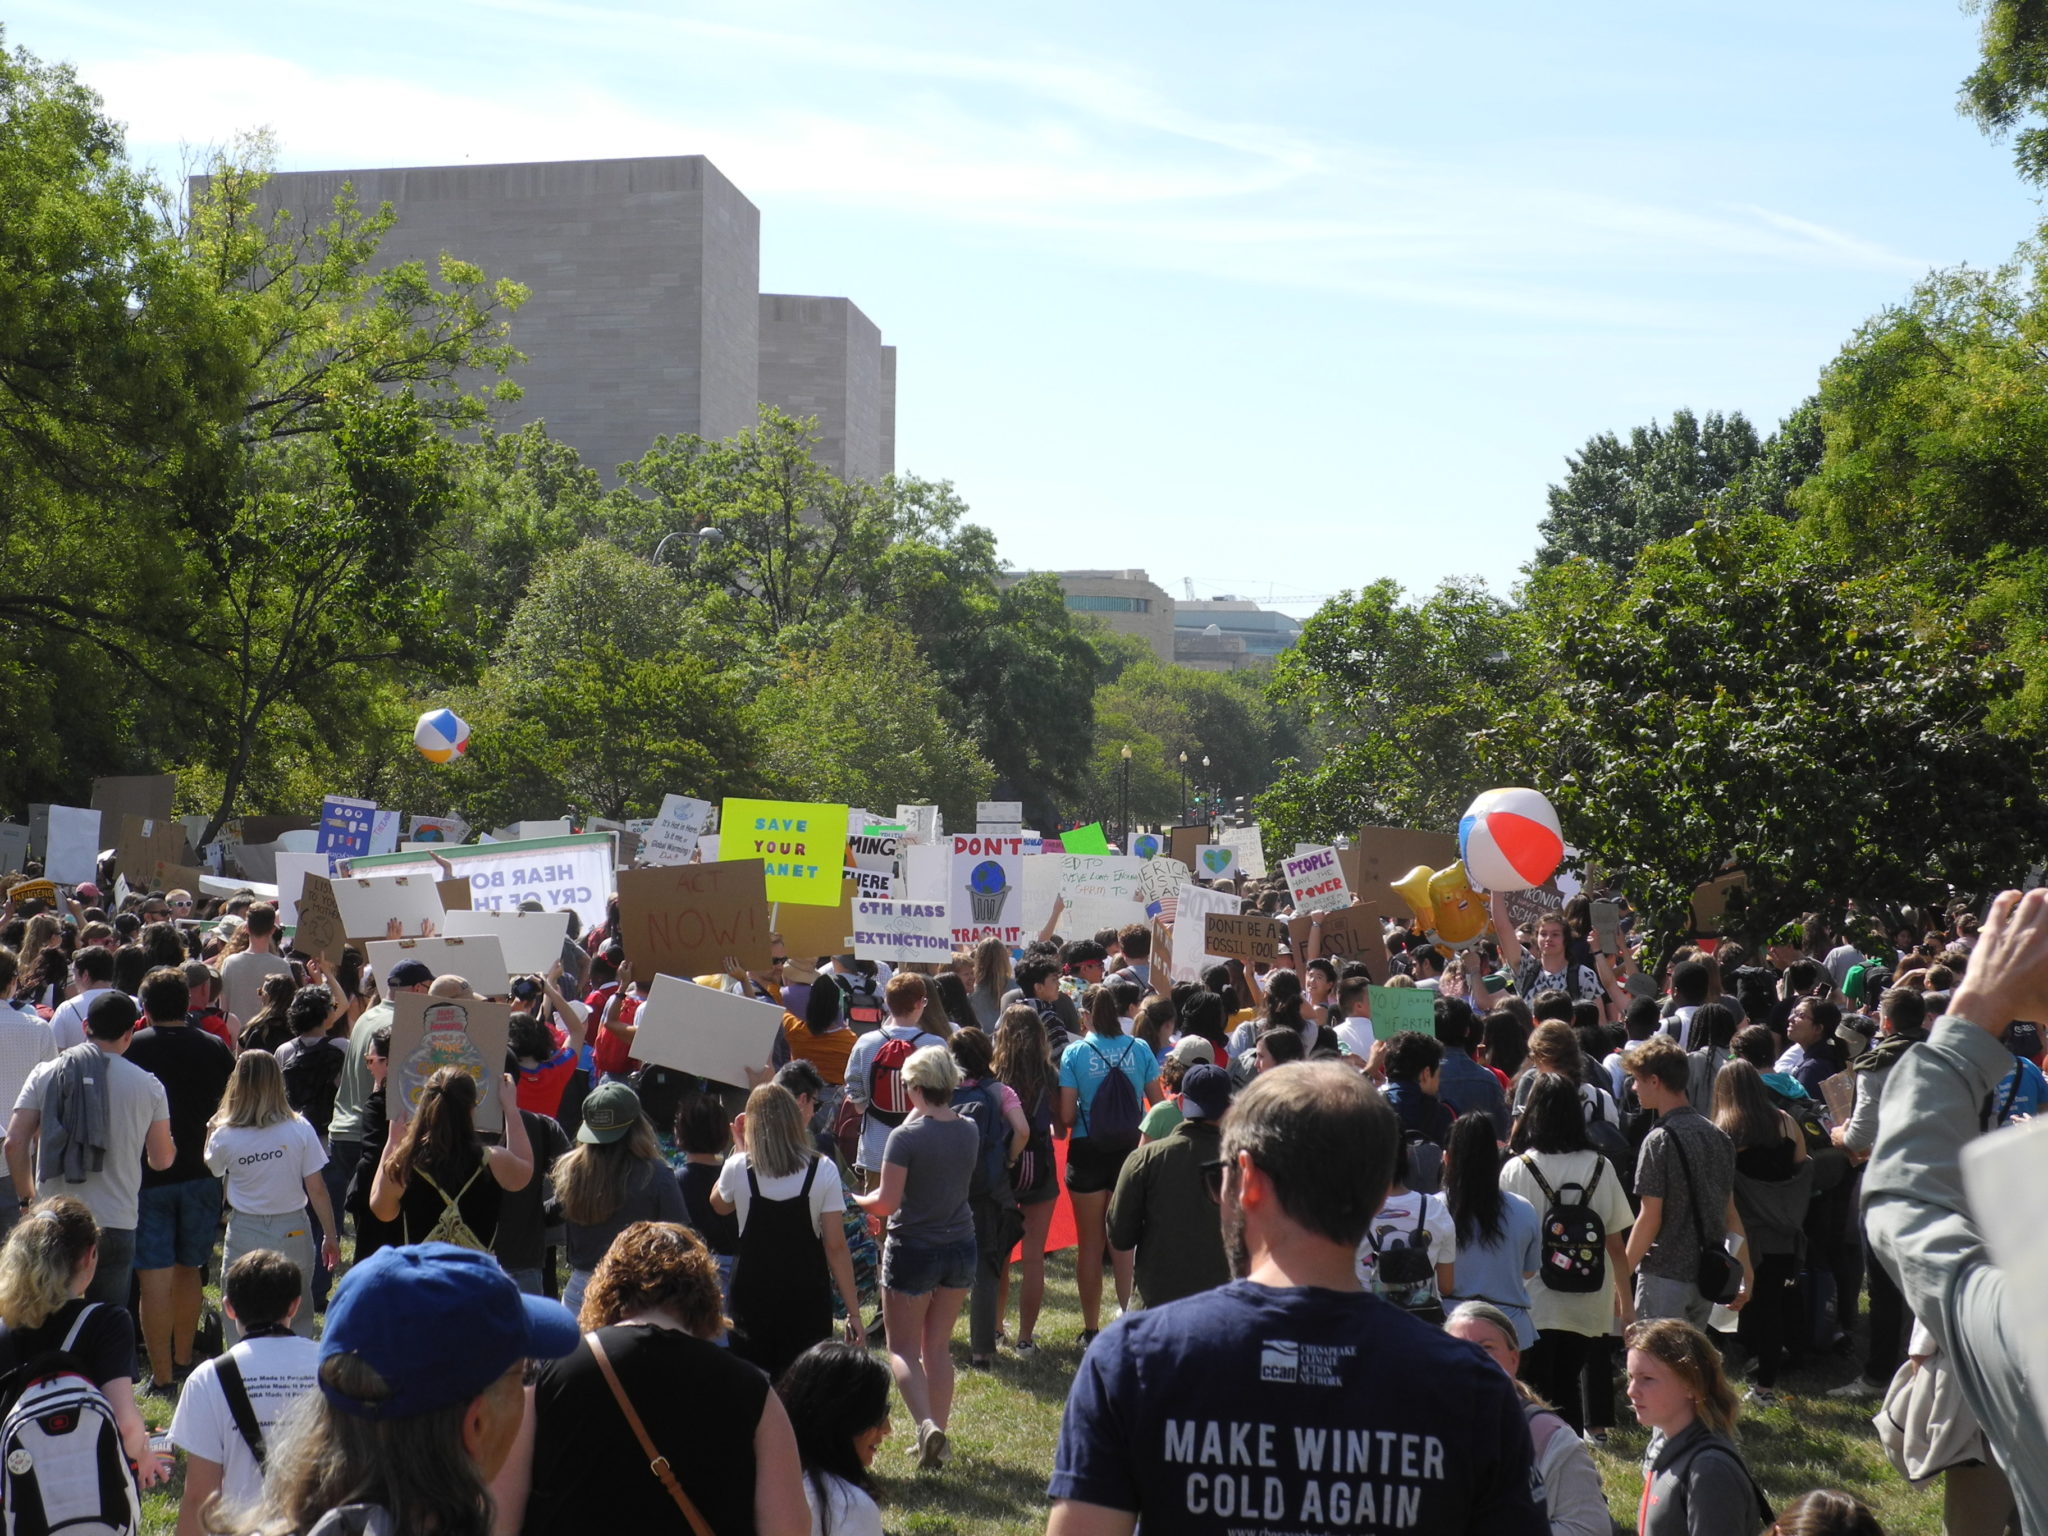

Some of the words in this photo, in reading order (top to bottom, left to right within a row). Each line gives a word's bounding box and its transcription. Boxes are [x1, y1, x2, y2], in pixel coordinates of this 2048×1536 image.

[755, 818, 807, 832] SAVE
[754, 840, 806, 855] YOUR
[849, 837, 896, 856] MING
[955, 837, 1022, 856] DON'T
[765, 863, 818, 878] ANET
[1287, 851, 1334, 877] PEOPLE
[676, 870, 723, 893] ACT
[1150, 887, 1180, 901] EAD
[859, 902, 893, 916] 6TH
[901, 904, 945, 918] MASS
[648, 907, 756, 953] NOW!
[1006, 927, 1020, 942] IT
[1208, 917, 1245, 934] DONT
[1248, 920, 1260, 936] BE
[1266, 924, 1277, 939] A
[855, 931, 949, 950] EXTINCTION
[1206, 936, 1249, 955] FOSSIL
[1251, 942, 1277, 959] FOOL
[1299, 928, 1370, 962] FSSIL
[1089, 1052, 1135, 1071] STEM
[239, 1150, 283, 1166] optoro
[1262, 1366, 1297, 1380] ccan
[1300, 1374, 1343, 1387] NETWORK
[1164, 1419, 1277, 1467] MAKE
[1294, 1426, 1445, 1480] WINTER
[1186, 1472, 1285, 1521] COLD
[1300, 1480, 1421, 1528] AGAIN
